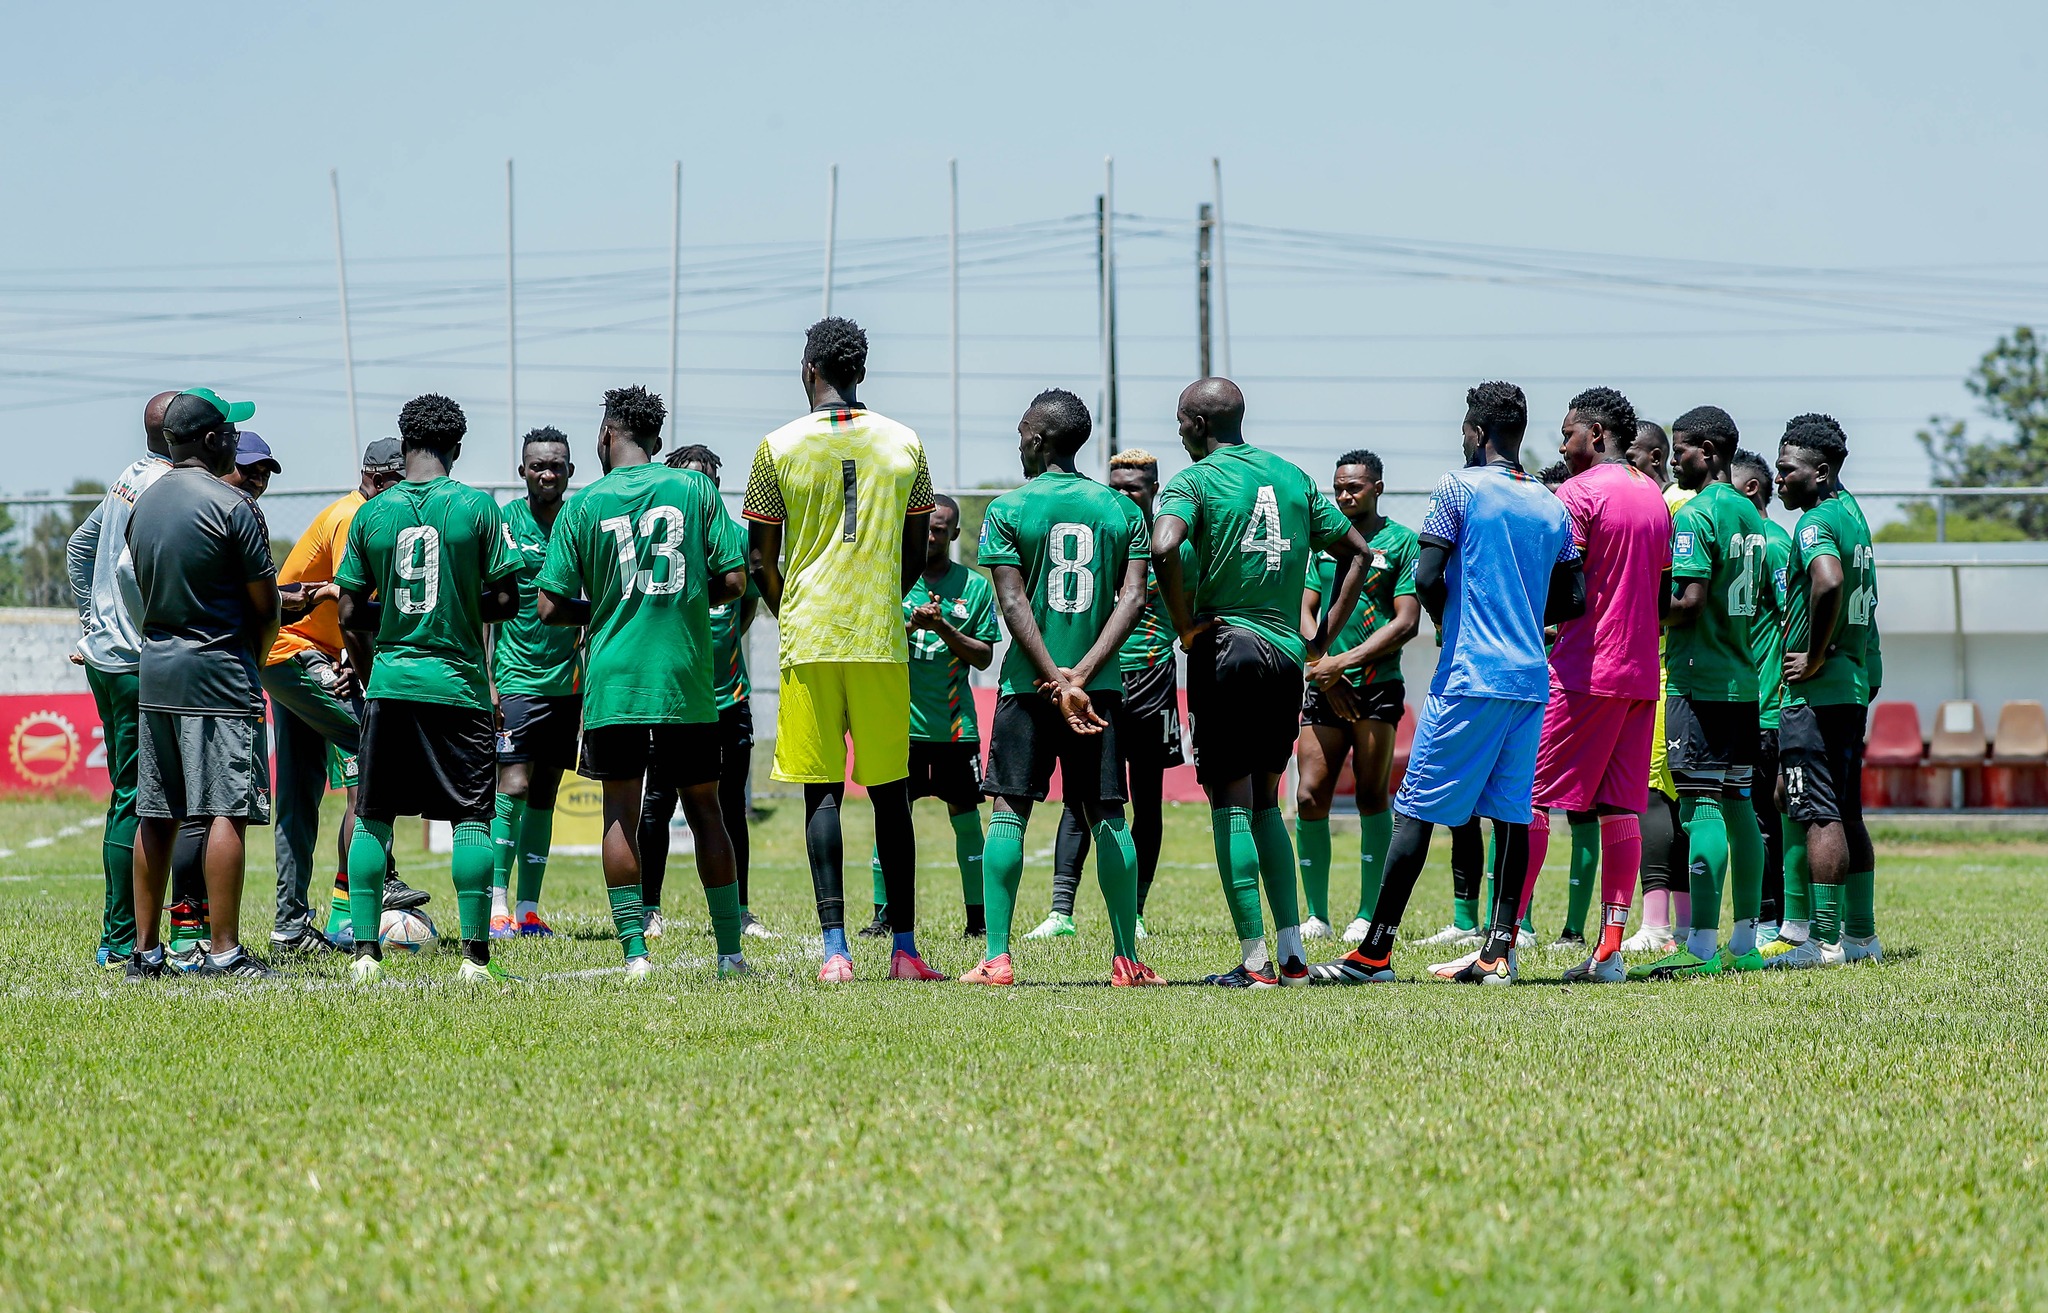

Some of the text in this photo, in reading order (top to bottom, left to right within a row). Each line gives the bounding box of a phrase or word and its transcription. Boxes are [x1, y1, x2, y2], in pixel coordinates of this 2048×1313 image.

[841, 459, 858, 543] 1
[1240, 485, 1291, 571] 4
[394, 525, 440, 615] 9
[600, 505, 687, 600] 13
[1047, 522, 1095, 614] 8
[1728, 532, 1766, 616] 20
[1160, 707, 1180, 743] 14
[568, 793, 603, 805] MTN
[1785, 766, 1804, 793] 21
